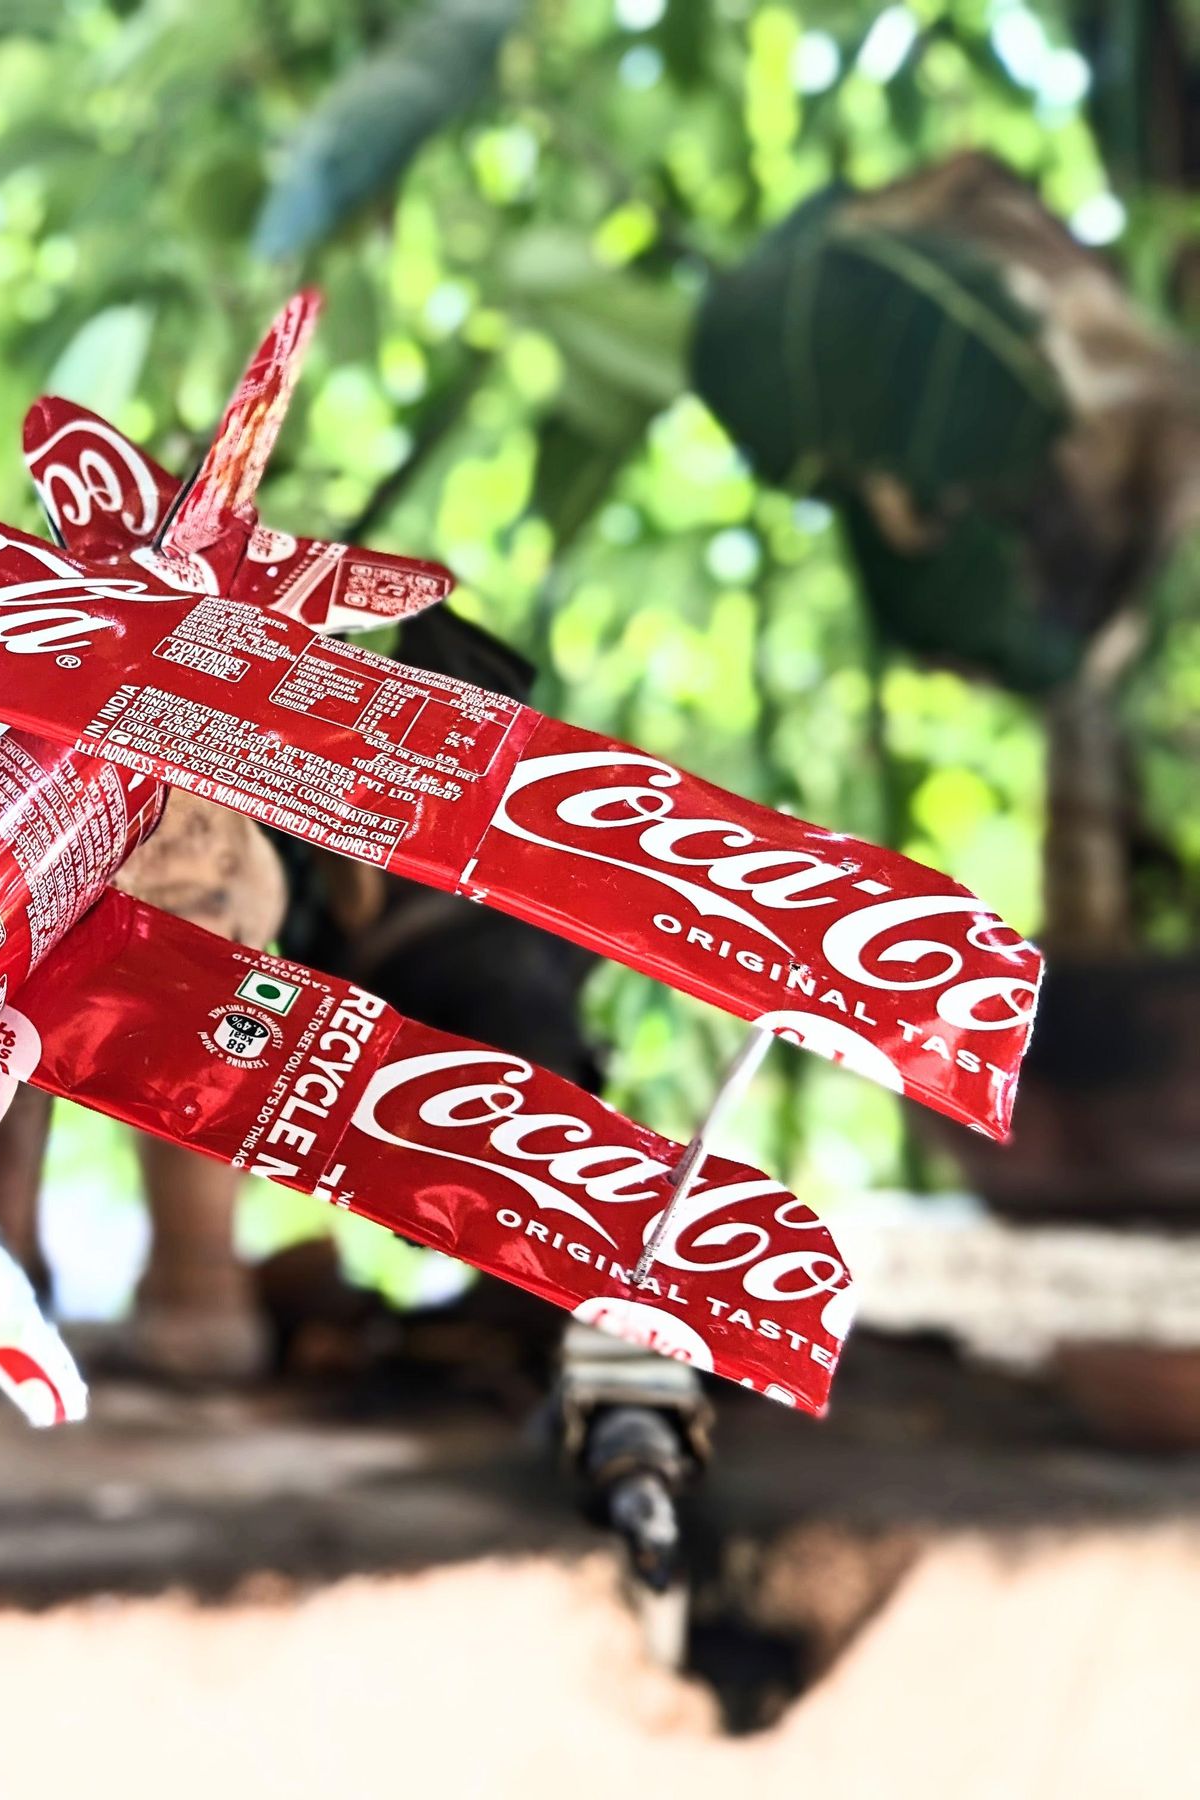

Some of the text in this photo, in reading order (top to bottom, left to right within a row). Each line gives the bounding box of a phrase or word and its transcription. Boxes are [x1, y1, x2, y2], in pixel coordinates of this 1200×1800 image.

[185, 614, 227, 630] CAFFEINE
[189, 609, 242, 628] REGULATOR
[194, 604, 264, 628] SUGAR, ACIDITY
[198, 600, 256, 619] CARBONATED
[170, 629, 234, 654] SUBSTANCES).
[175, 624, 277, 661] (NATURAL FLAVOURING
[180, 619, 297, 662] COLOUR FLAVOURS
[297, 662, 399, 701] CARBOHYDRATE 10.9
[301, 655, 415, 699] ENERGY kcal
[316, 634, 484, 696] NUTRITION INFORMATION (APPROXIMATE
[318, 641, 508, 709] SERVING SERVINGS IN THIS PACK
[83, 679, 140, 739] IN INDIA
[142, 684, 258, 733] MANUFACTURED BY
[277, 687, 316, 705] PROTEIN
[320, 678, 395, 708] SUGARS 10.6
[324, 687, 391, 714] SUGARS 10.6
[384, 677, 497, 720] PER 100ml PER SERVE
[272, 694, 308, 711] SODIUM
[357, 723, 373, 733] 8.5
[371, 730, 389, 740] mg
[282, 680, 461, 748] TOTAL FAT 0%
[123, 706, 349, 800] DIST. PUNE 412111, MAHARASHTRA.
[129, 699, 358, 793] 1105/7/8/33 PIRANGUT, TAL. MULSHI,
[135, 691, 389, 795] HINDUSTAN COCA-COLA BEVERAGES PVT.
[26, 765, 42, 780] BY
[118, 719, 402, 835] CONTACT CONSUMER RESPONSE COORDINATOR AT:
[349, 756, 461, 803] 10012022000287
[394, 748, 478, 783] ON 2000 kcal DIET
[419, 773, 442, 786] Lic.
[445, 779, 463, 794] No.
[71, 777, 100, 839] MRP OF
[94, 801, 105, 814] OF
[98, 742, 387, 862] ADDRESS SAME AS MANUFACTURED BY ADDRESS
[128, 736, 396, 849] 1800-208-2653 indiahelpline@coca-cola.com
[10, 841, 29, 870] PVT.
[19, 823, 44, 857] DISTT.
[74, 848, 82, 861] AS
[23, 868, 44, 930] BEVERAGES
[25, 901, 34, 918] BY
[231, 952, 331, 993] CARBONATED
[258, 954, 311, 977] WATER
[652, 913, 877, 1026] ORIGINAL
[207, 1006, 226, 1018] PACK
[229, 1015, 265, 1037] 4.4%
[245, 1006, 256, 1015] IN
[256, 1010, 282, 1038] SERVINGS
[197, 1031, 262, 1066] SERVING 200ml
[225, 1037, 246, 1054] 88
[228, 1028, 253, 1045] kcal
[241, 993, 336, 1151] NICE TO SEE YOU. LET'S DO THIS
[265, 983, 386, 1161] RECYCLE
[496, 1208, 689, 1305] ORIGINAL
[706, 1297, 836, 1370] TASTE
